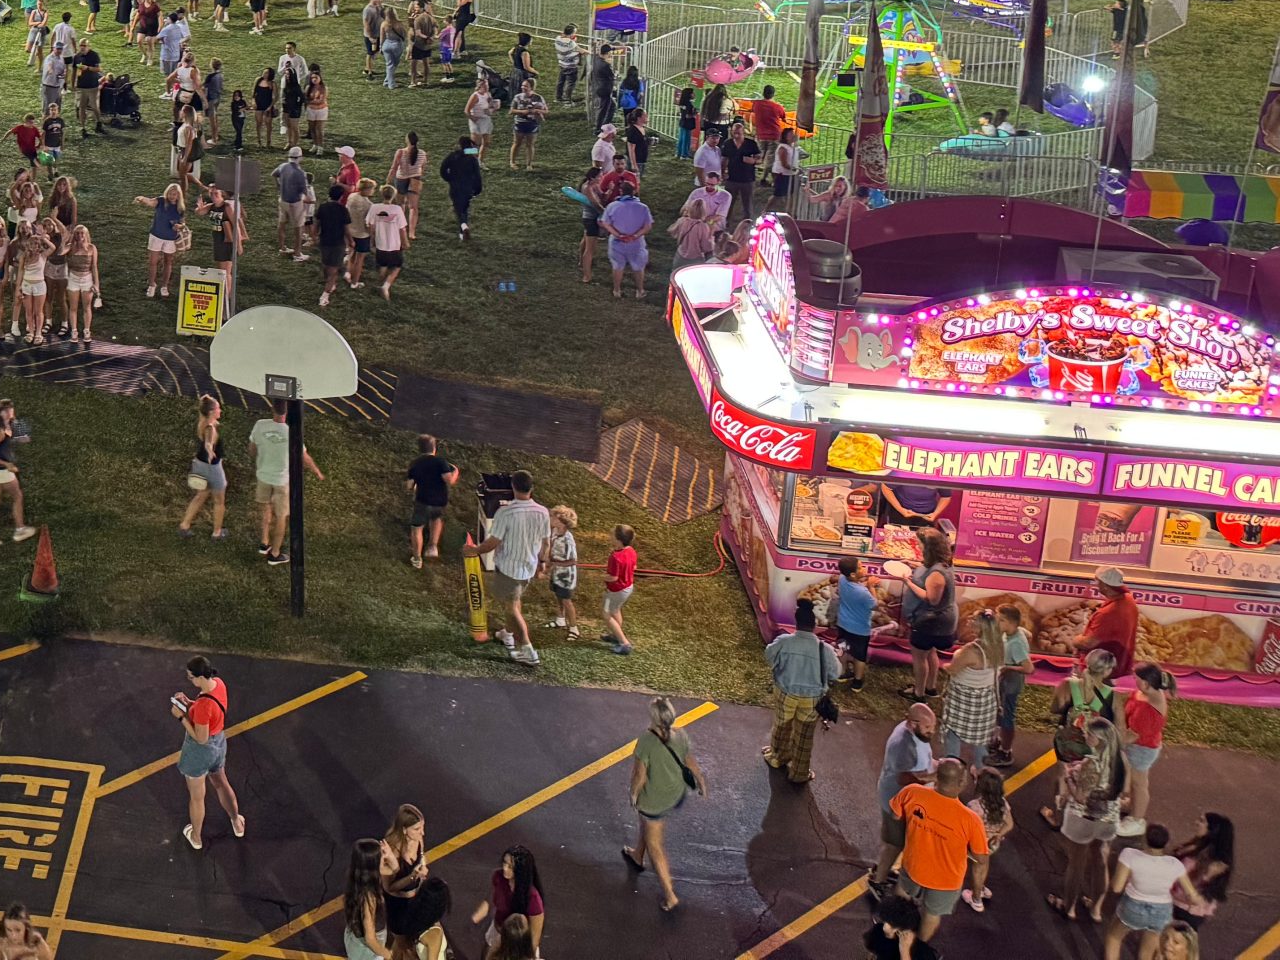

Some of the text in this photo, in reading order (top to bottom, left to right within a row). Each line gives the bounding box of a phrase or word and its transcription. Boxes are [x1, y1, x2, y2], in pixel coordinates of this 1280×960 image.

[188, 283, 216, 292] CAUTION
[941, 304, 1242, 371] Shelby's Sweet Shop
[943, 351, 1004, 365] ELEPHANT
[956, 361, 986, 373] EARS
[1174, 369, 1220, 381] FUNNEL
[1176, 378, 1216, 390] CAKES
[712, 400, 802, 463] Coca-Cola
[885, 443, 1094, 485] ELEPHANT EARS
[1115, 463, 1228, 496] FUNNEL
[970, 490, 1005, 499] ELEPHANT
[992, 514, 1017, 522] DRINKS
[988, 531, 1015, 539] WATER
[1081, 533, 1100, 544] Bring
[1108, 533, 1125, 542] Back
[1126, 533, 1138, 542] For
[1139, 532, 1145, 542] A
[1081, 544, 1119, 555] Discounted
[1031, 581, 1086, 595] FRUIT
